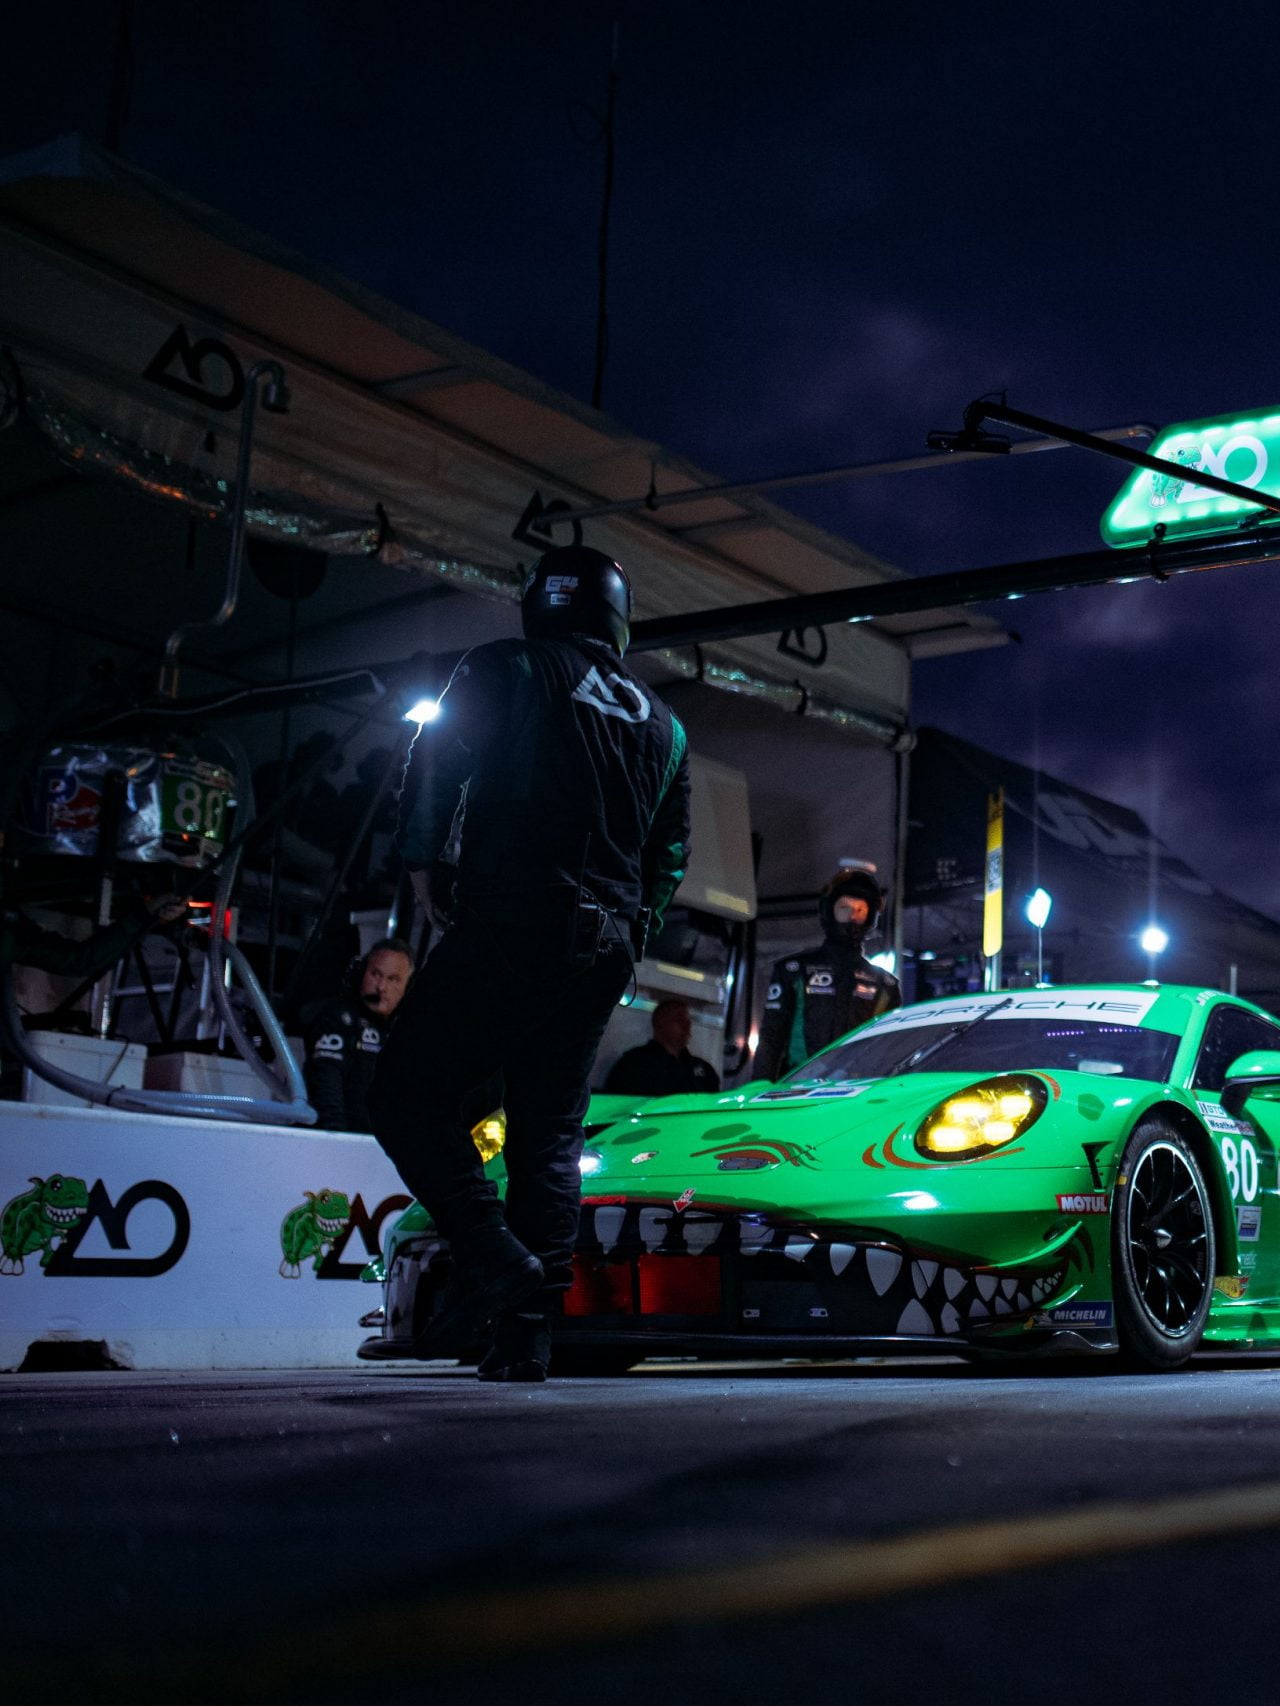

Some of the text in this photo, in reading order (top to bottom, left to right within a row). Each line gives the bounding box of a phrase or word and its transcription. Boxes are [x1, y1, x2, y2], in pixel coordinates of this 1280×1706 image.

[173, 781, 225, 836] 80
[1221, 1136, 1258, 1202] 80
[1060, 1195, 1109, 1214] MOTUL
[1053, 1308, 1108, 1321] MICHELIN
